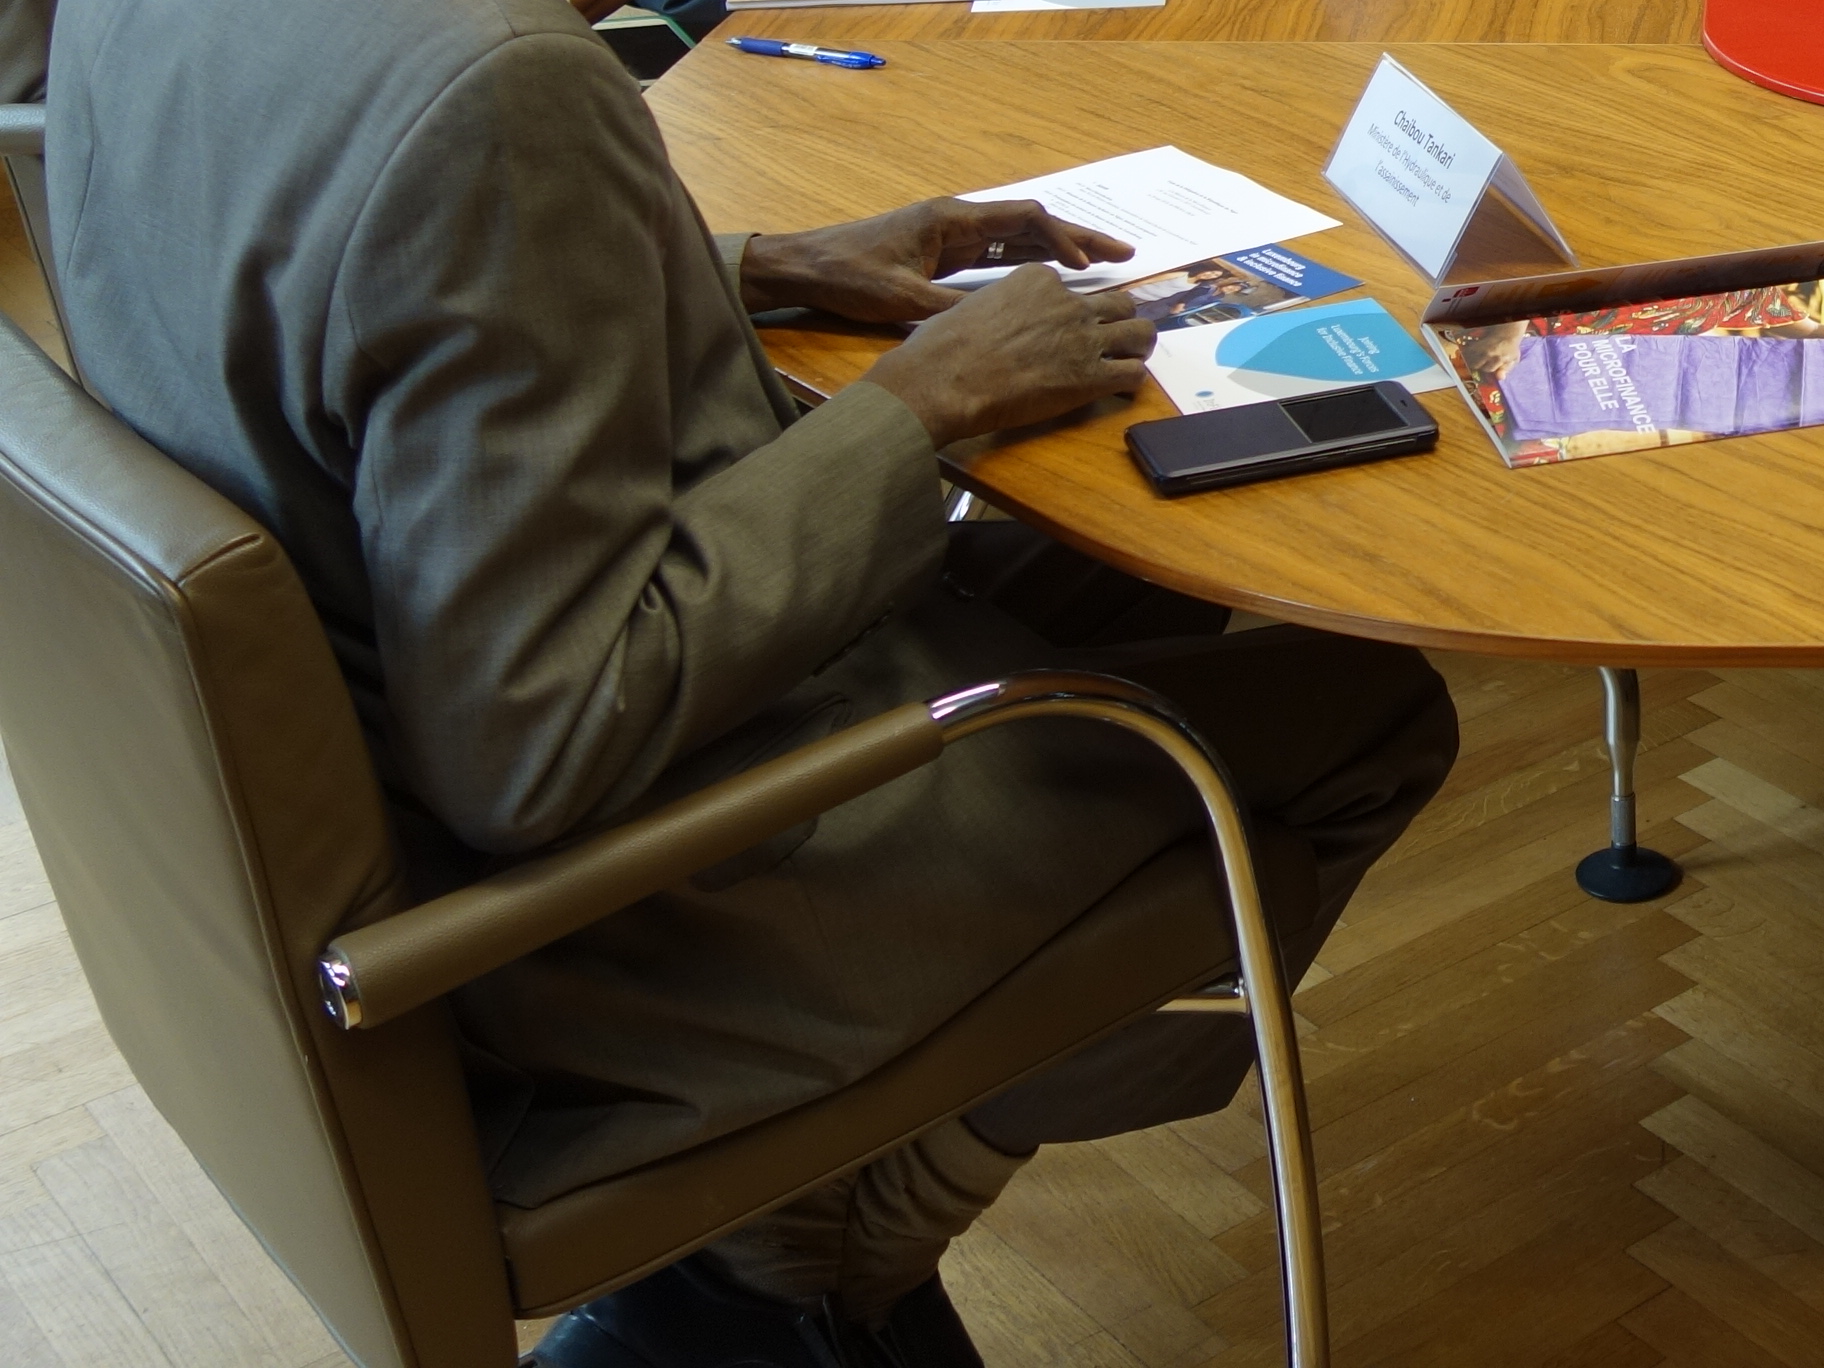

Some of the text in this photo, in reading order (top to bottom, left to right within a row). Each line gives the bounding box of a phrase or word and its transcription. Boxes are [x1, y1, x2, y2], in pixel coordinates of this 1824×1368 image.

[1367, 123, 1394, 153] Ministère
[1391, 145, 1401, 159] de
[1434, 184, 1444, 197] et
[1441, 187, 1452, 203] de
[1393, 110, 1456, 169] Chaibou Tankari
[1568, 342, 1620, 411] POUR ELLE
[1614, 334, 1638, 353] LA
[1591, 339, 1656, 435] MICROFINANCE
